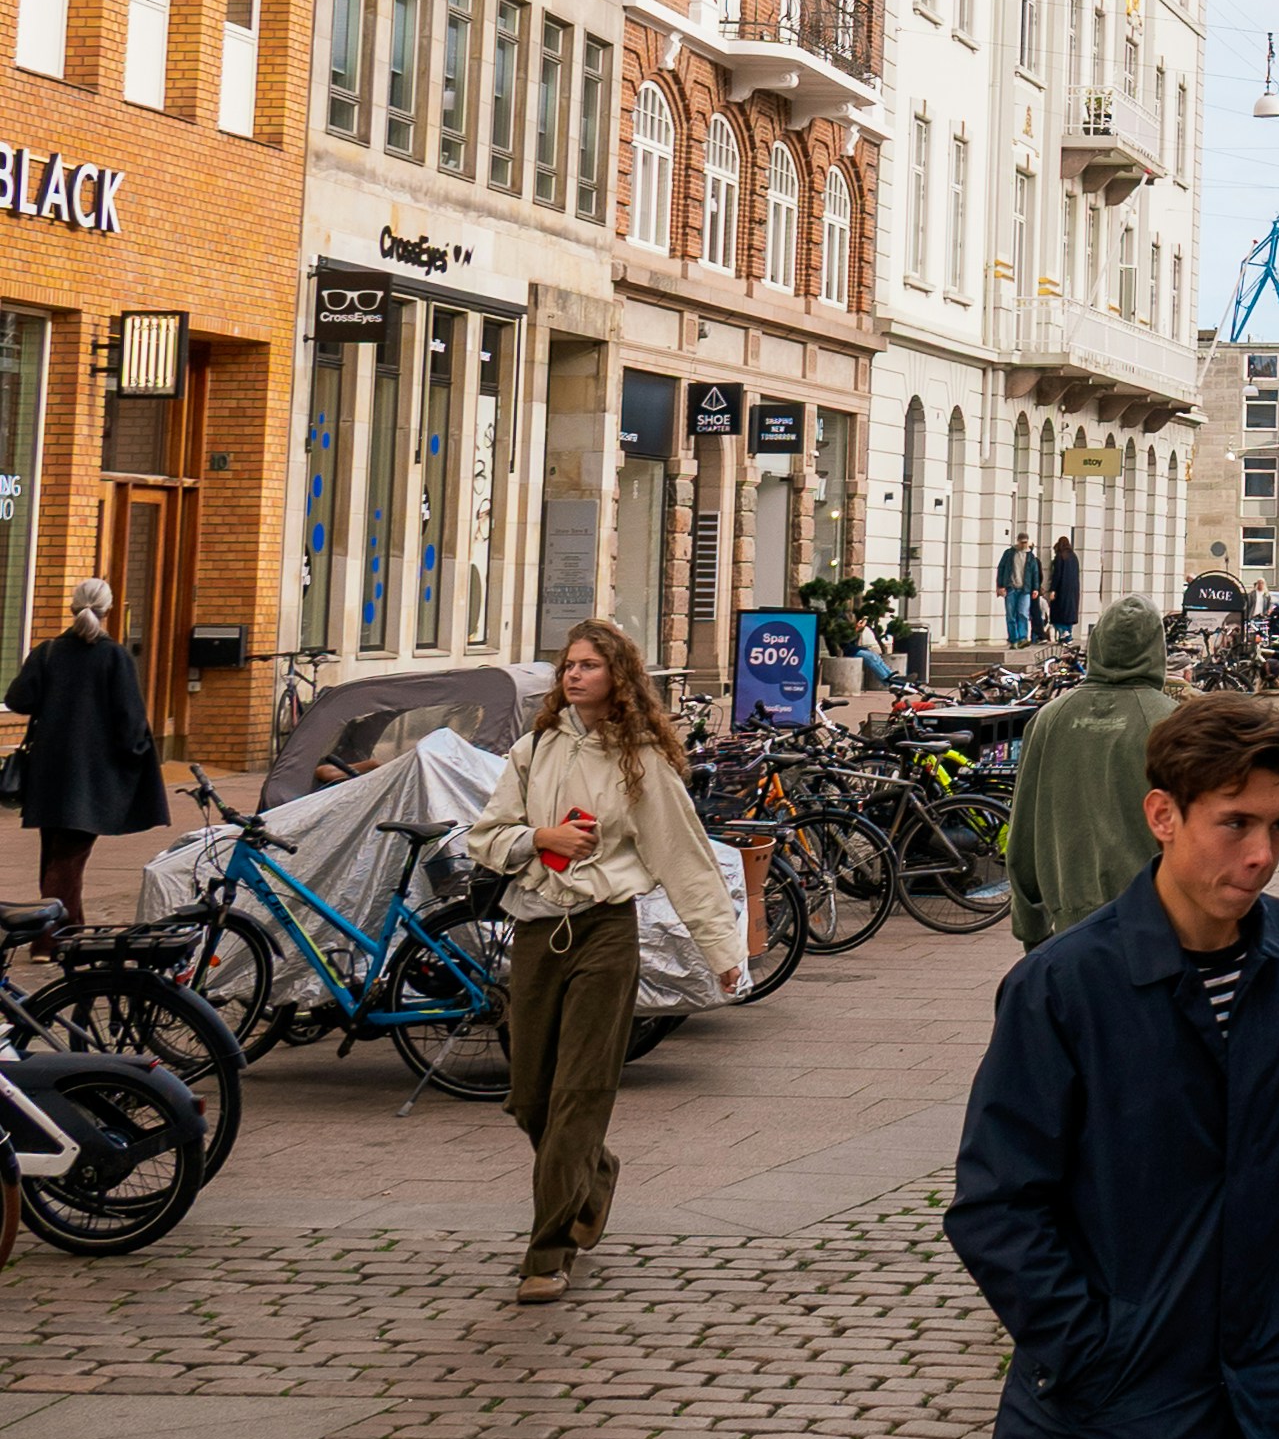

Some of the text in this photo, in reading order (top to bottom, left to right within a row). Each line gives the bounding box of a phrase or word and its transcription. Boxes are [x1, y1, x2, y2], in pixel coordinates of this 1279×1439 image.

[0, 141, 126, 234] BLACK
[379, 225, 450, 276] CrossEyes
[320, 312, 383, 324] CrossEyes
[697, 414, 731, 425] SHOE
[1199, 587, 1234, 602] N'AGE
[762, 632, 791, 645] Spar
[749, 647, 799, 666] 50%
